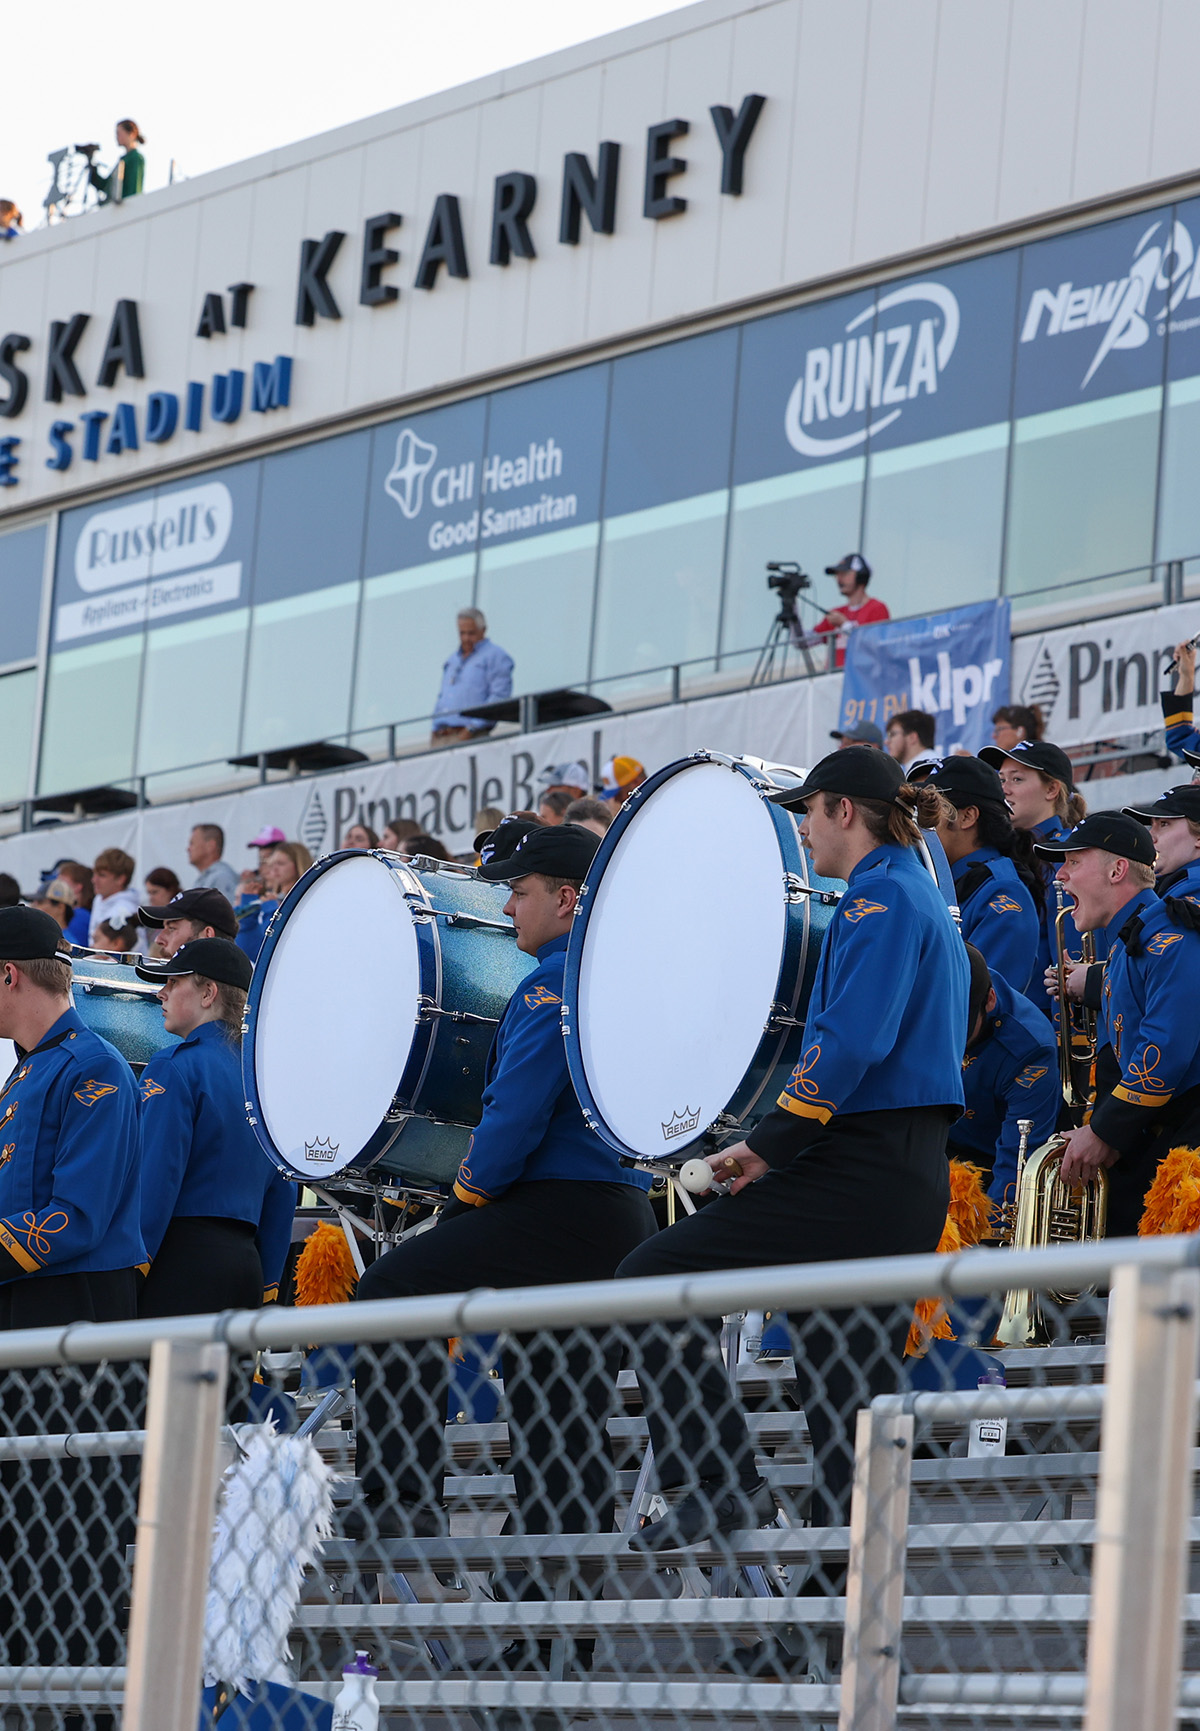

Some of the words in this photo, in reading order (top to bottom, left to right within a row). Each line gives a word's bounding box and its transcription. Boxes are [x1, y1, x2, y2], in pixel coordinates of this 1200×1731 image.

[196, 282, 254, 339] AT
[296, 94, 767, 327] KEARNEY
[45, 355, 294, 471] STADIUM
[431, 461, 475, 507] CHI
[482, 437, 563, 496] Health
[88, 503, 218, 570] Russell's
[428, 509, 480, 551] Good
[481, 493, 578, 538] Samaritan
[909, 651, 1003, 726] klpr
[308, 1149, 334, 1160] REMO
[666, 1117, 696, 1136] REMO
